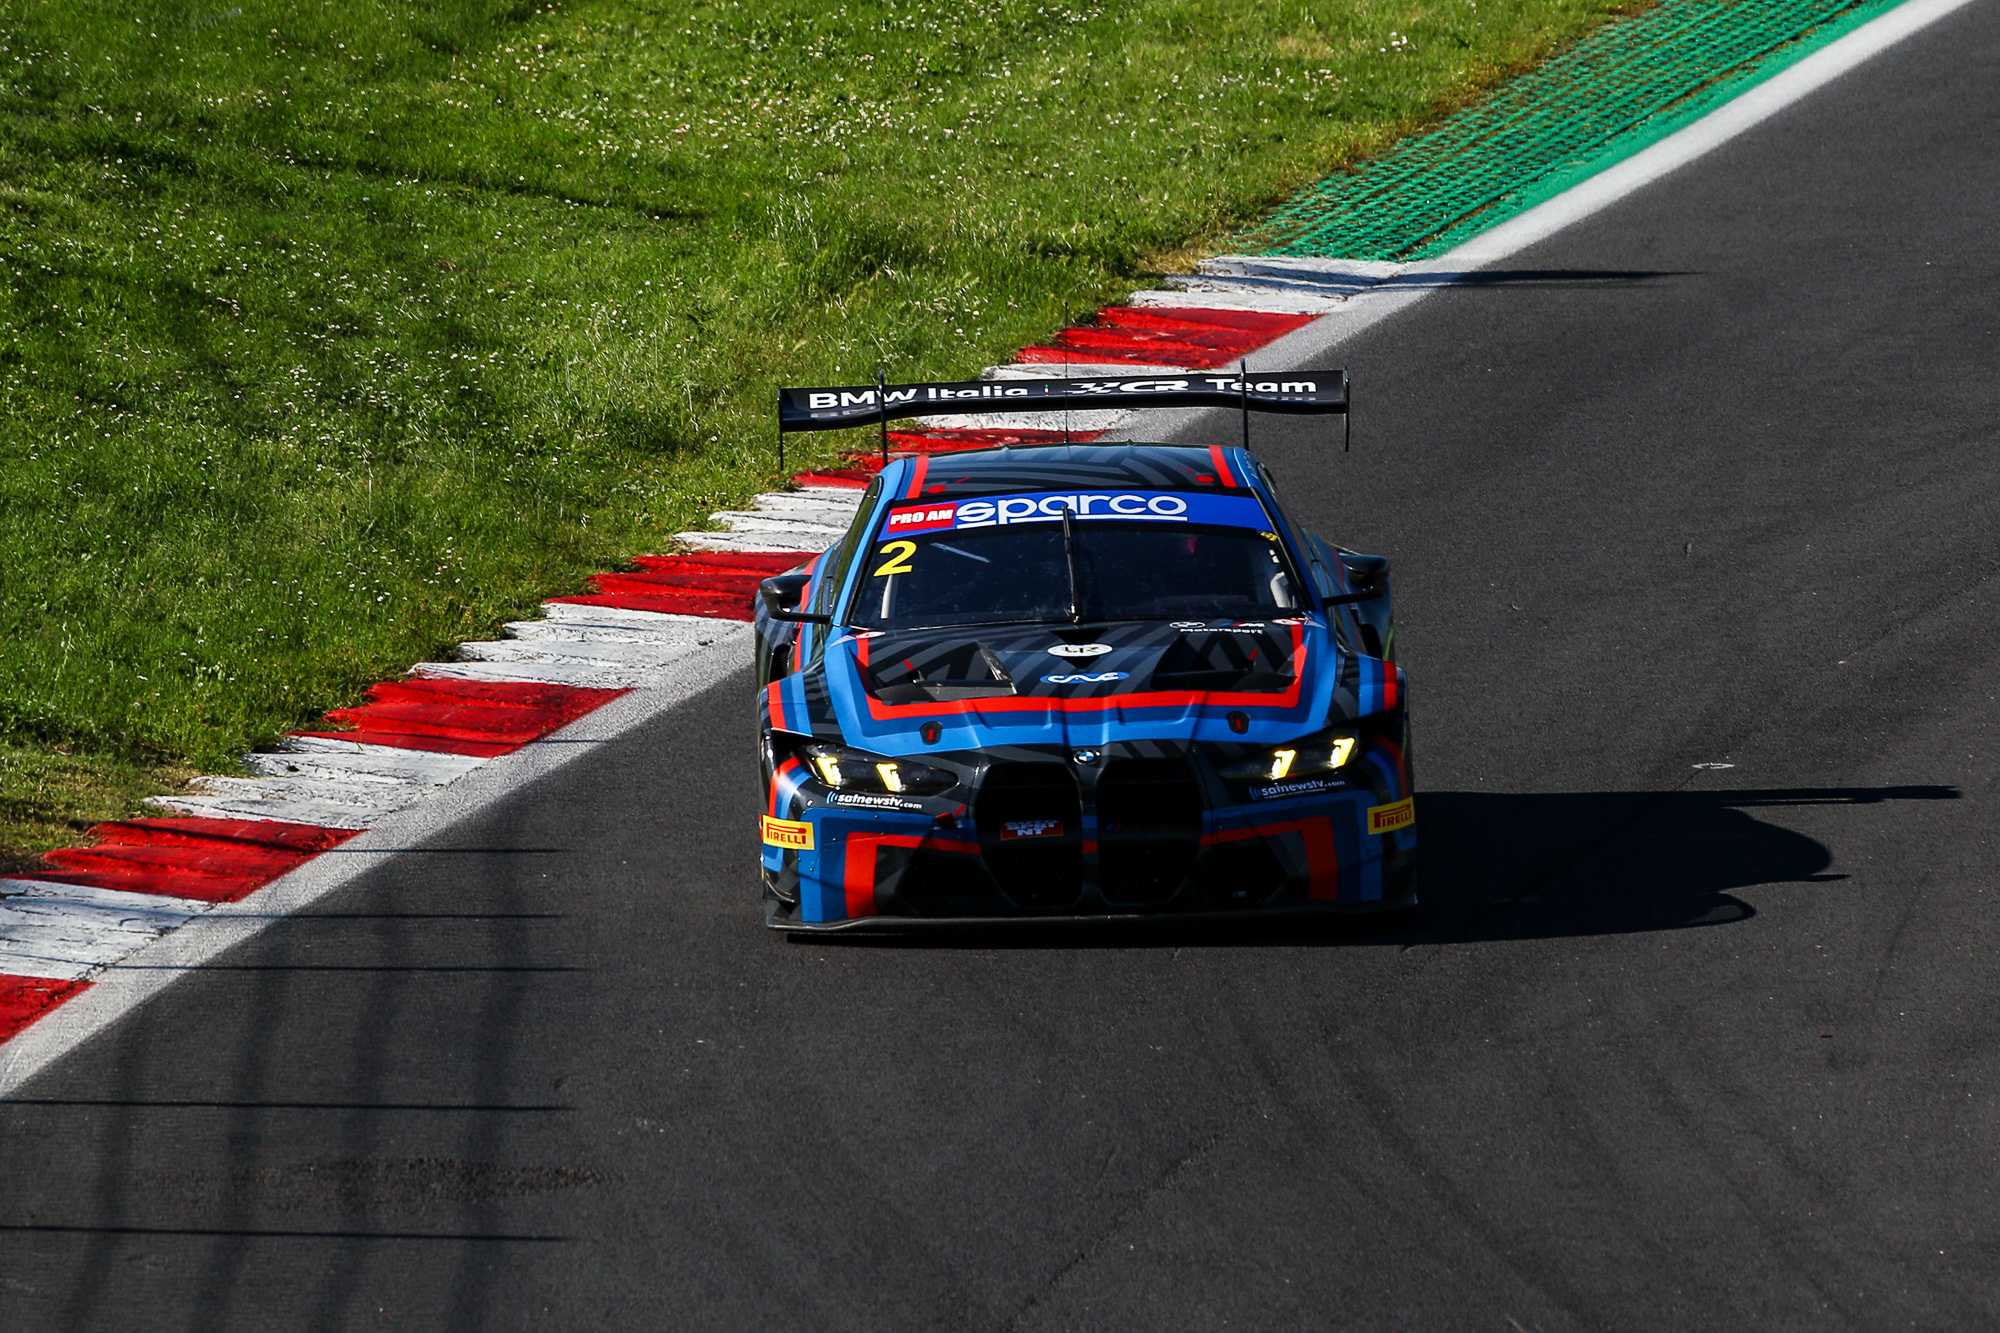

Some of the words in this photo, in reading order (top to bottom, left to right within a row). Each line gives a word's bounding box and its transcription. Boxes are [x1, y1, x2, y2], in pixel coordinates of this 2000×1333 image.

[809, 388, 917, 409] BMW
[928, 385, 1028, 399] Italia
[1205, 378, 1317, 393] Team
[890, 511, 924, 525] PRO
[926, 509, 954, 521] AM
[956, 494, 1188, 525] sparco
[873, 540, 917, 577] 2
[1374, 803, 1413, 828] PIRELLI
[766, 822, 807, 845] PIRELLI
